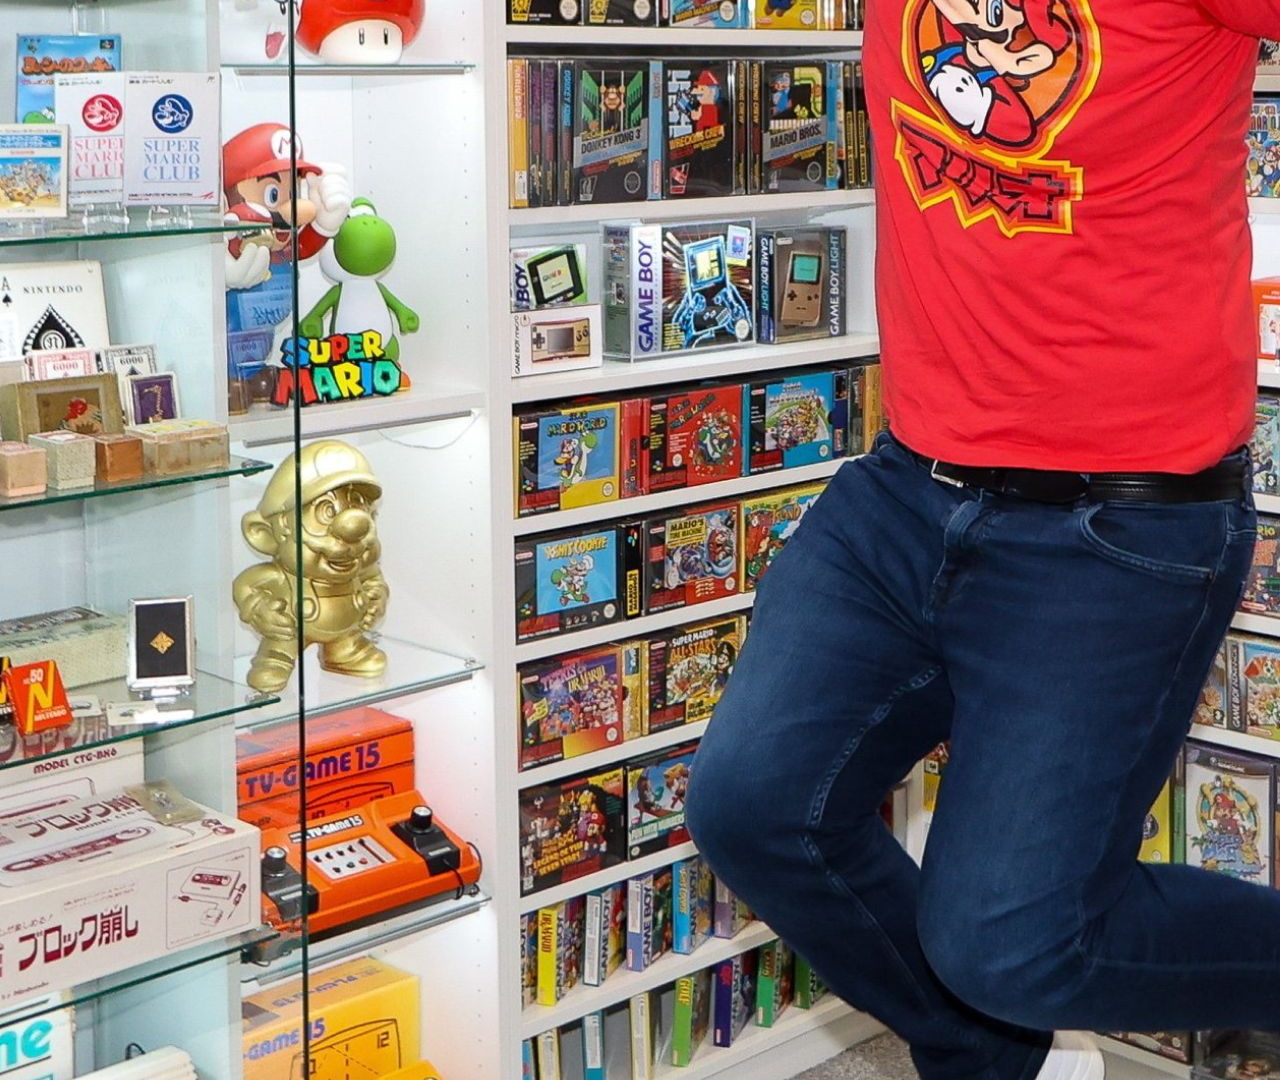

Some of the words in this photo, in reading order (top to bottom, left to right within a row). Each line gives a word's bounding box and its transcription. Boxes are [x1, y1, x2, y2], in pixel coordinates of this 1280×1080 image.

[144, 139, 200, 153] SUPER
[581, 136, 613, 155] DONKEY
[613, 131, 635, 148] KONG
[770, 131, 797, 148] MARIO
[144, 154, 201, 165] MARIO
[144, 166, 200, 180] CLUB
[637, 239, 654, 283] BOY
[829, 233, 840, 276] LIGHT
[0, 276, 12, 293] A
[22, 284, 84, 294] NINTENDO
[516, 263, 530, 305] BOY
[829, 279, 840, 304] BOY
[637, 296, 654, 353] GAME
[829, 306, 840, 336] GAME
[280, 329, 384, 367] SUPER
[51, 361, 80, 372] 6000
[120, 356, 145, 367] 6000
[272, 359, 403, 406] MARIO
[670, 519, 705, 533] MARIO'S
[672, 633, 693, 647] SUPER
[693, 629, 715, 640] MARIO
[28, 668, 44, 683] 50
[355, 741, 382, 770] 15
[33, 758, 70, 775] MODEL
[642, 885, 655, 919] BOY
[18, 904, 139, 972] ブロック崩し
